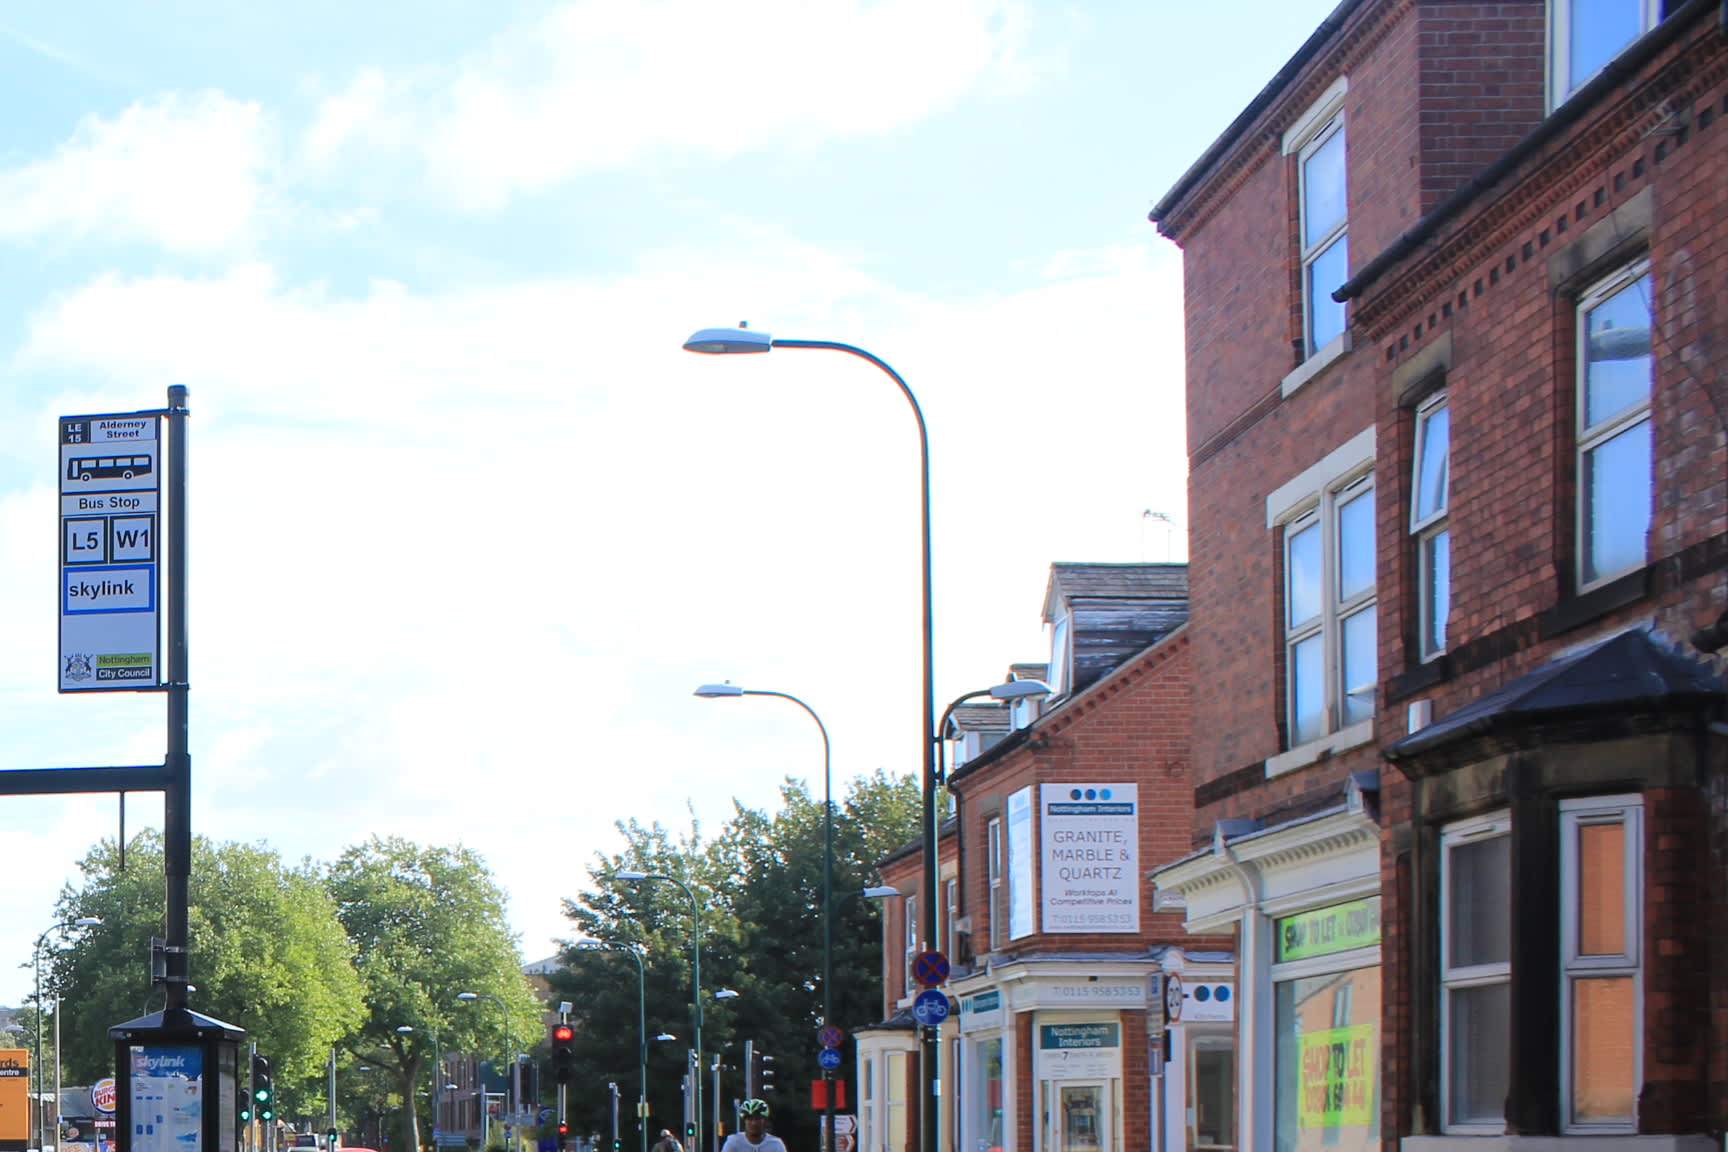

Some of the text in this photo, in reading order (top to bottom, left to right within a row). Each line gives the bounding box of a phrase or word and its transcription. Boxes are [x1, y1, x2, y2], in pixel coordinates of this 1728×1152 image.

[67, 423, 82, 433] LE
[100, 420, 147, 430] Alderney
[68, 433, 82, 443] 15
[107, 429, 140, 439] Street
[79, 496, 140, 509] Bus Stop
[72, 531, 99, 551] L5
[115, 529, 149, 549] W1
[69, 579, 134, 600] skylink
[98, 655, 150, 666] Nottingham
[98, 668, 150, 679] City Council
[1053, 830, 1128, 846] GRANITE,
[1052, 848, 1129, 861] MARBLE &
[1059, 867, 1122, 881] QUARTZ
[1051, 1026, 1109, 1039] Nottingham
[1058, 1037, 1102, 1047] Interiors
[136, 1055, 185, 1070] skylink
[1332, 1042, 1345, 1078] TO
